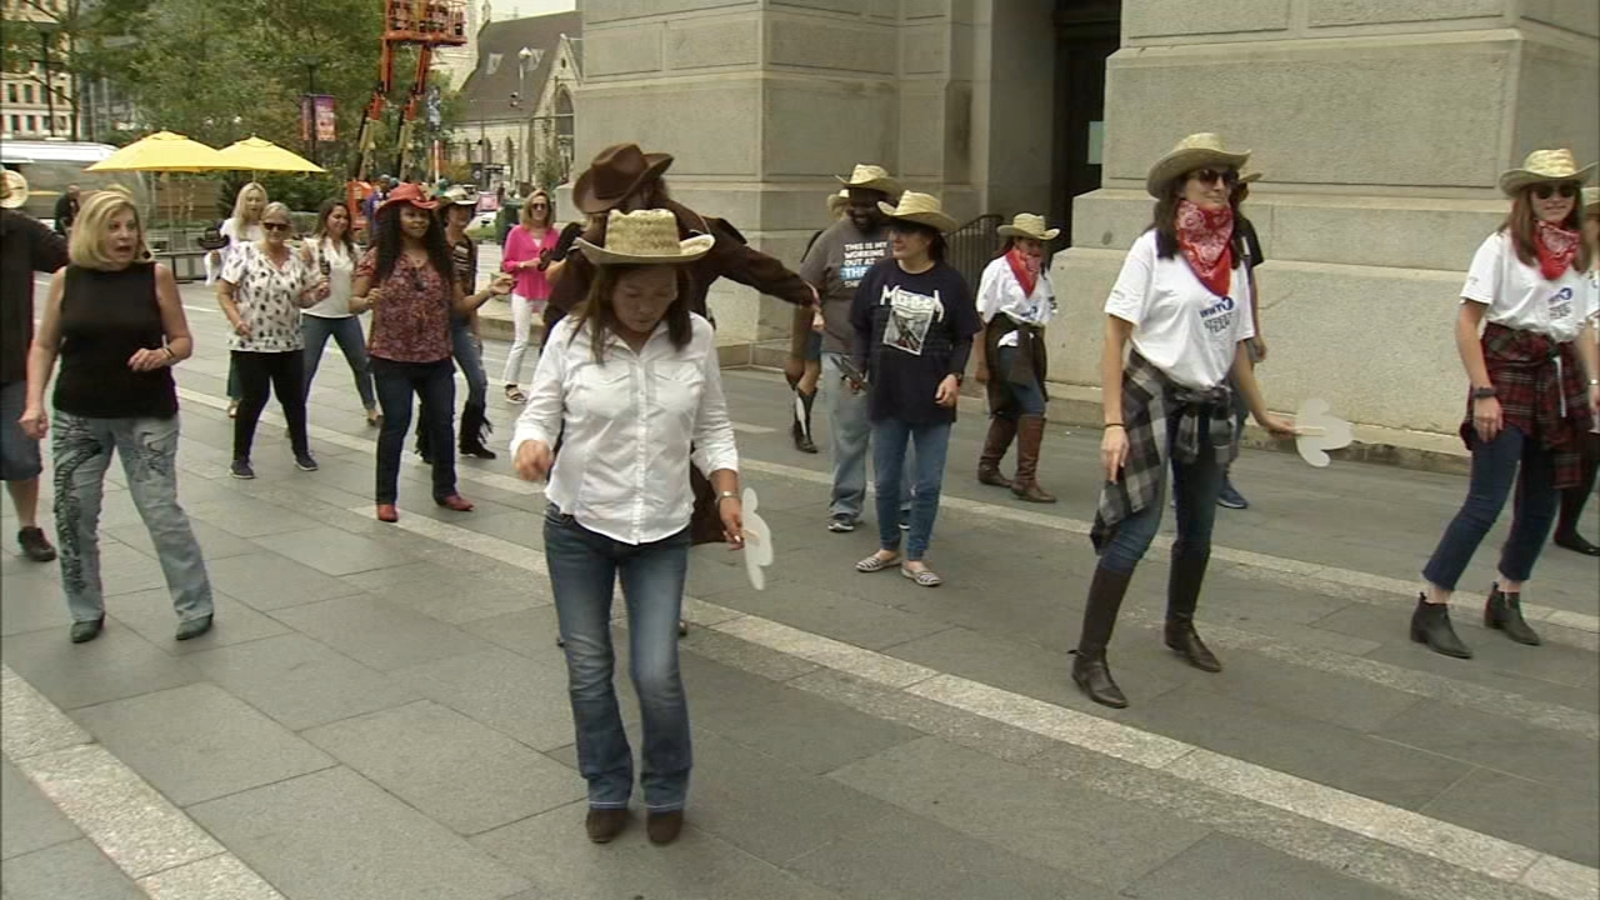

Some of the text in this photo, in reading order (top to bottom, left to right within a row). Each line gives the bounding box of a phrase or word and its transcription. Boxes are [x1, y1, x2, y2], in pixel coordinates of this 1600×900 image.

[844, 241, 888, 251] THIS IS MY
[844, 249, 886, 259] WORKING
[844, 257, 876, 267] OUT AT
